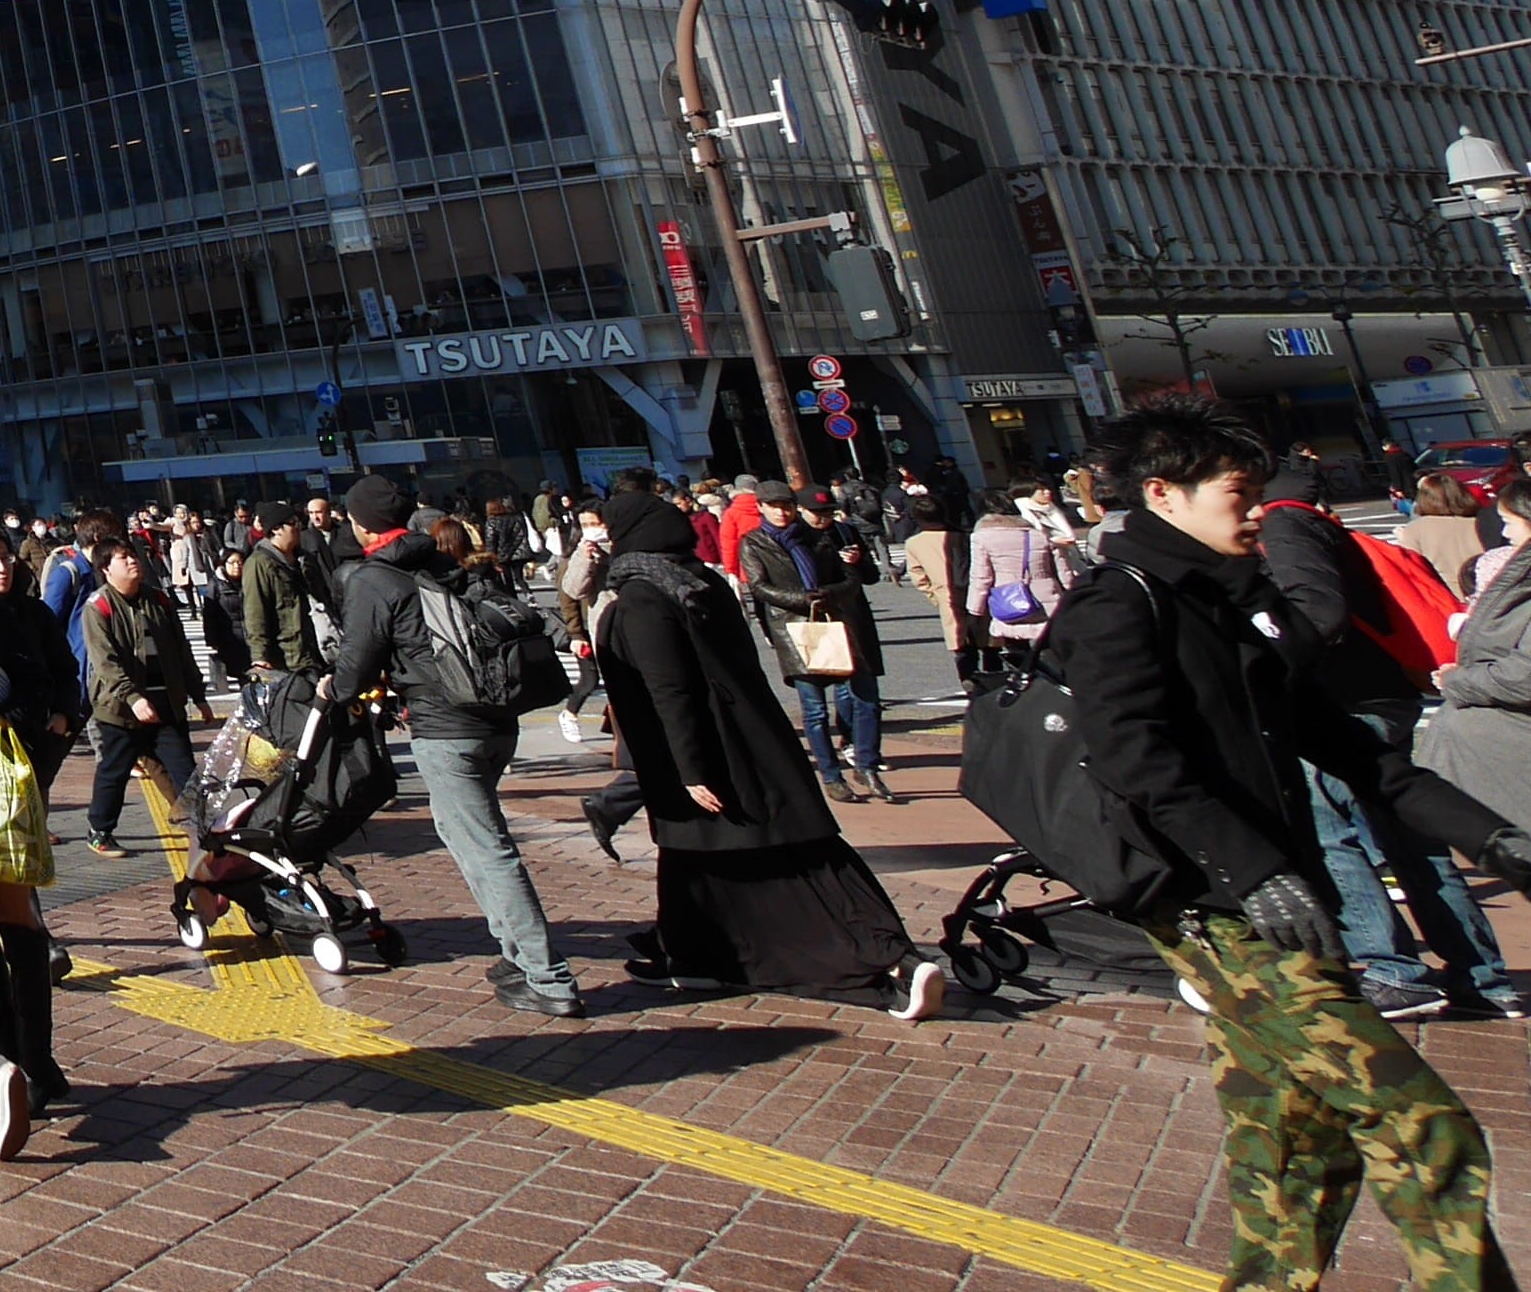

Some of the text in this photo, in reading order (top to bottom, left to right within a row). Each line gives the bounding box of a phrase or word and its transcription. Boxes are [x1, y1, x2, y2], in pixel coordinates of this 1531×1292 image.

[404, 323, 637, 375] TSUTAYA
[1266, 327, 1334, 357] SEIBU
[967, 379, 1025, 398] TSUTAYA
